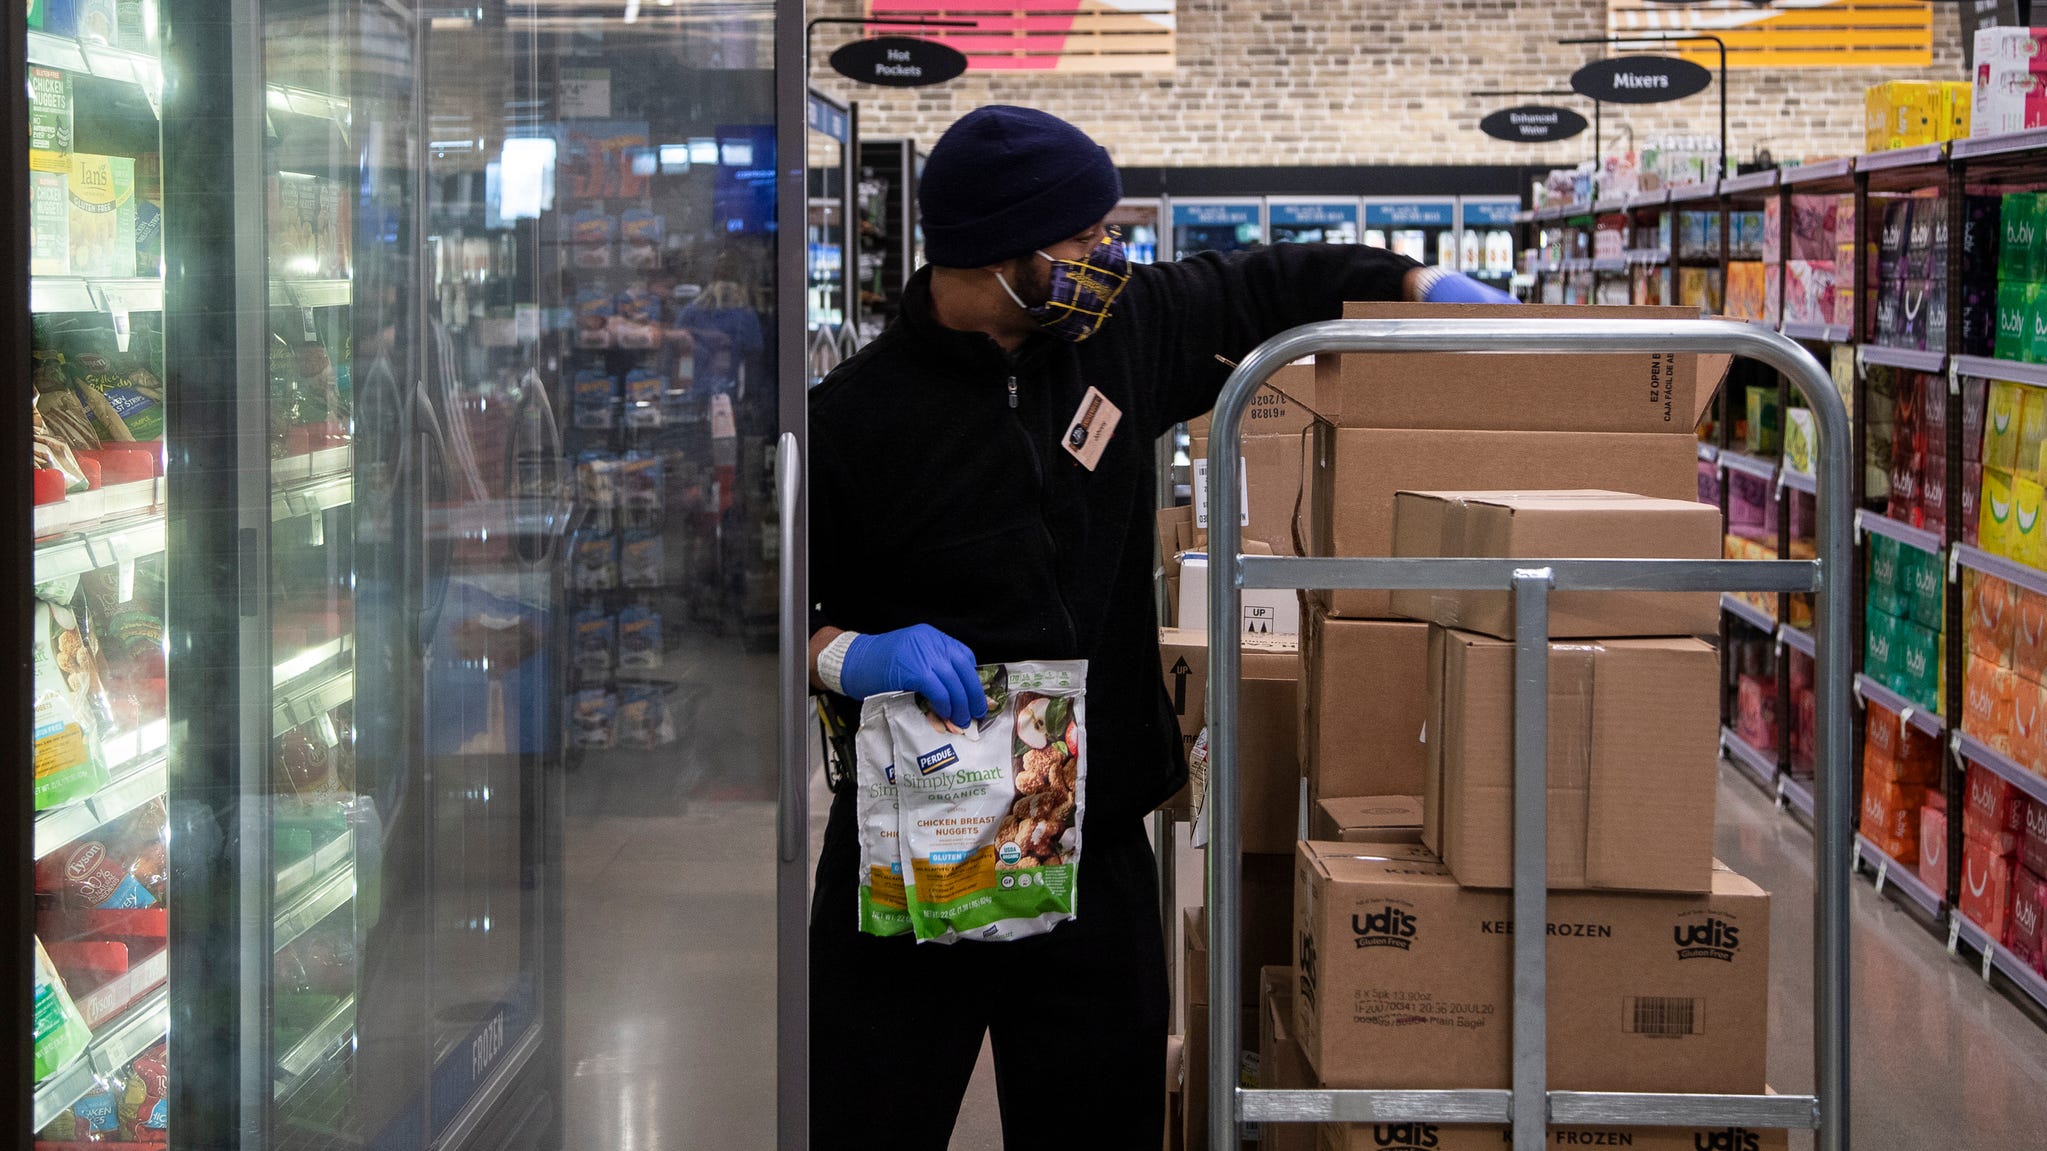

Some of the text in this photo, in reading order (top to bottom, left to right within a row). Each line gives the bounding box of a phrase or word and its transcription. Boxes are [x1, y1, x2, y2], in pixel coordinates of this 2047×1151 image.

[887, 49, 910, 61] Hot
[875, 63, 922, 77] Pockets
[33, 77, 64, 94] CHICKEN
[1613, 73, 1668, 89] Mixers
[33, 93, 66, 109] NUGGETS
[1510, 112, 1558, 124] Enhanced
[1519, 125, 1548, 136] Water
[74, 197, 112, 211] GLUTEN FREE
[2007, 220, 2034, 249] bubly
[2001, 307, 2024, 338] bubly
[1650, 361, 1661, 402] EZ OPEN
[1663, 365, 1674, 422] CAJA FÁCIL DE
[1253, 608, 1266, 617] UP
[1869, 630, 1889, 662] bubly
[1176, 665, 1188, 674] UP
[1907, 646, 1927, 678] bubly
[1970, 684, 1993, 720] bubly
[920, 747, 953, 768] PERDUE
[928, 787, 987, 801] ORGANICS
[1972, 778, 1996, 817] bubly
[1866, 793, 1884, 826] bubly
[917, 816, 996, 827] CHICKEN BREAST
[936, 826, 979, 836] NUGGETS
[69, 844, 101, 874] Tyson
[932, 853, 962, 862] GLUTEN
[1003, 878, 1013, 886] GF
[1352, 906, 1417, 937] udi's
[2016, 893, 2037, 936] bubly
[1674, 918, 1739, 949] udi's
[1360, 937, 1408, 948] Gluten Free
[1681, 950, 1729, 959] Gluten Free
[1450, 1004, 1494, 1014] 20JUL20
[473, 1010, 504, 1081] FROZEN
[1556, 1131, 1633, 1146] FROZEN
